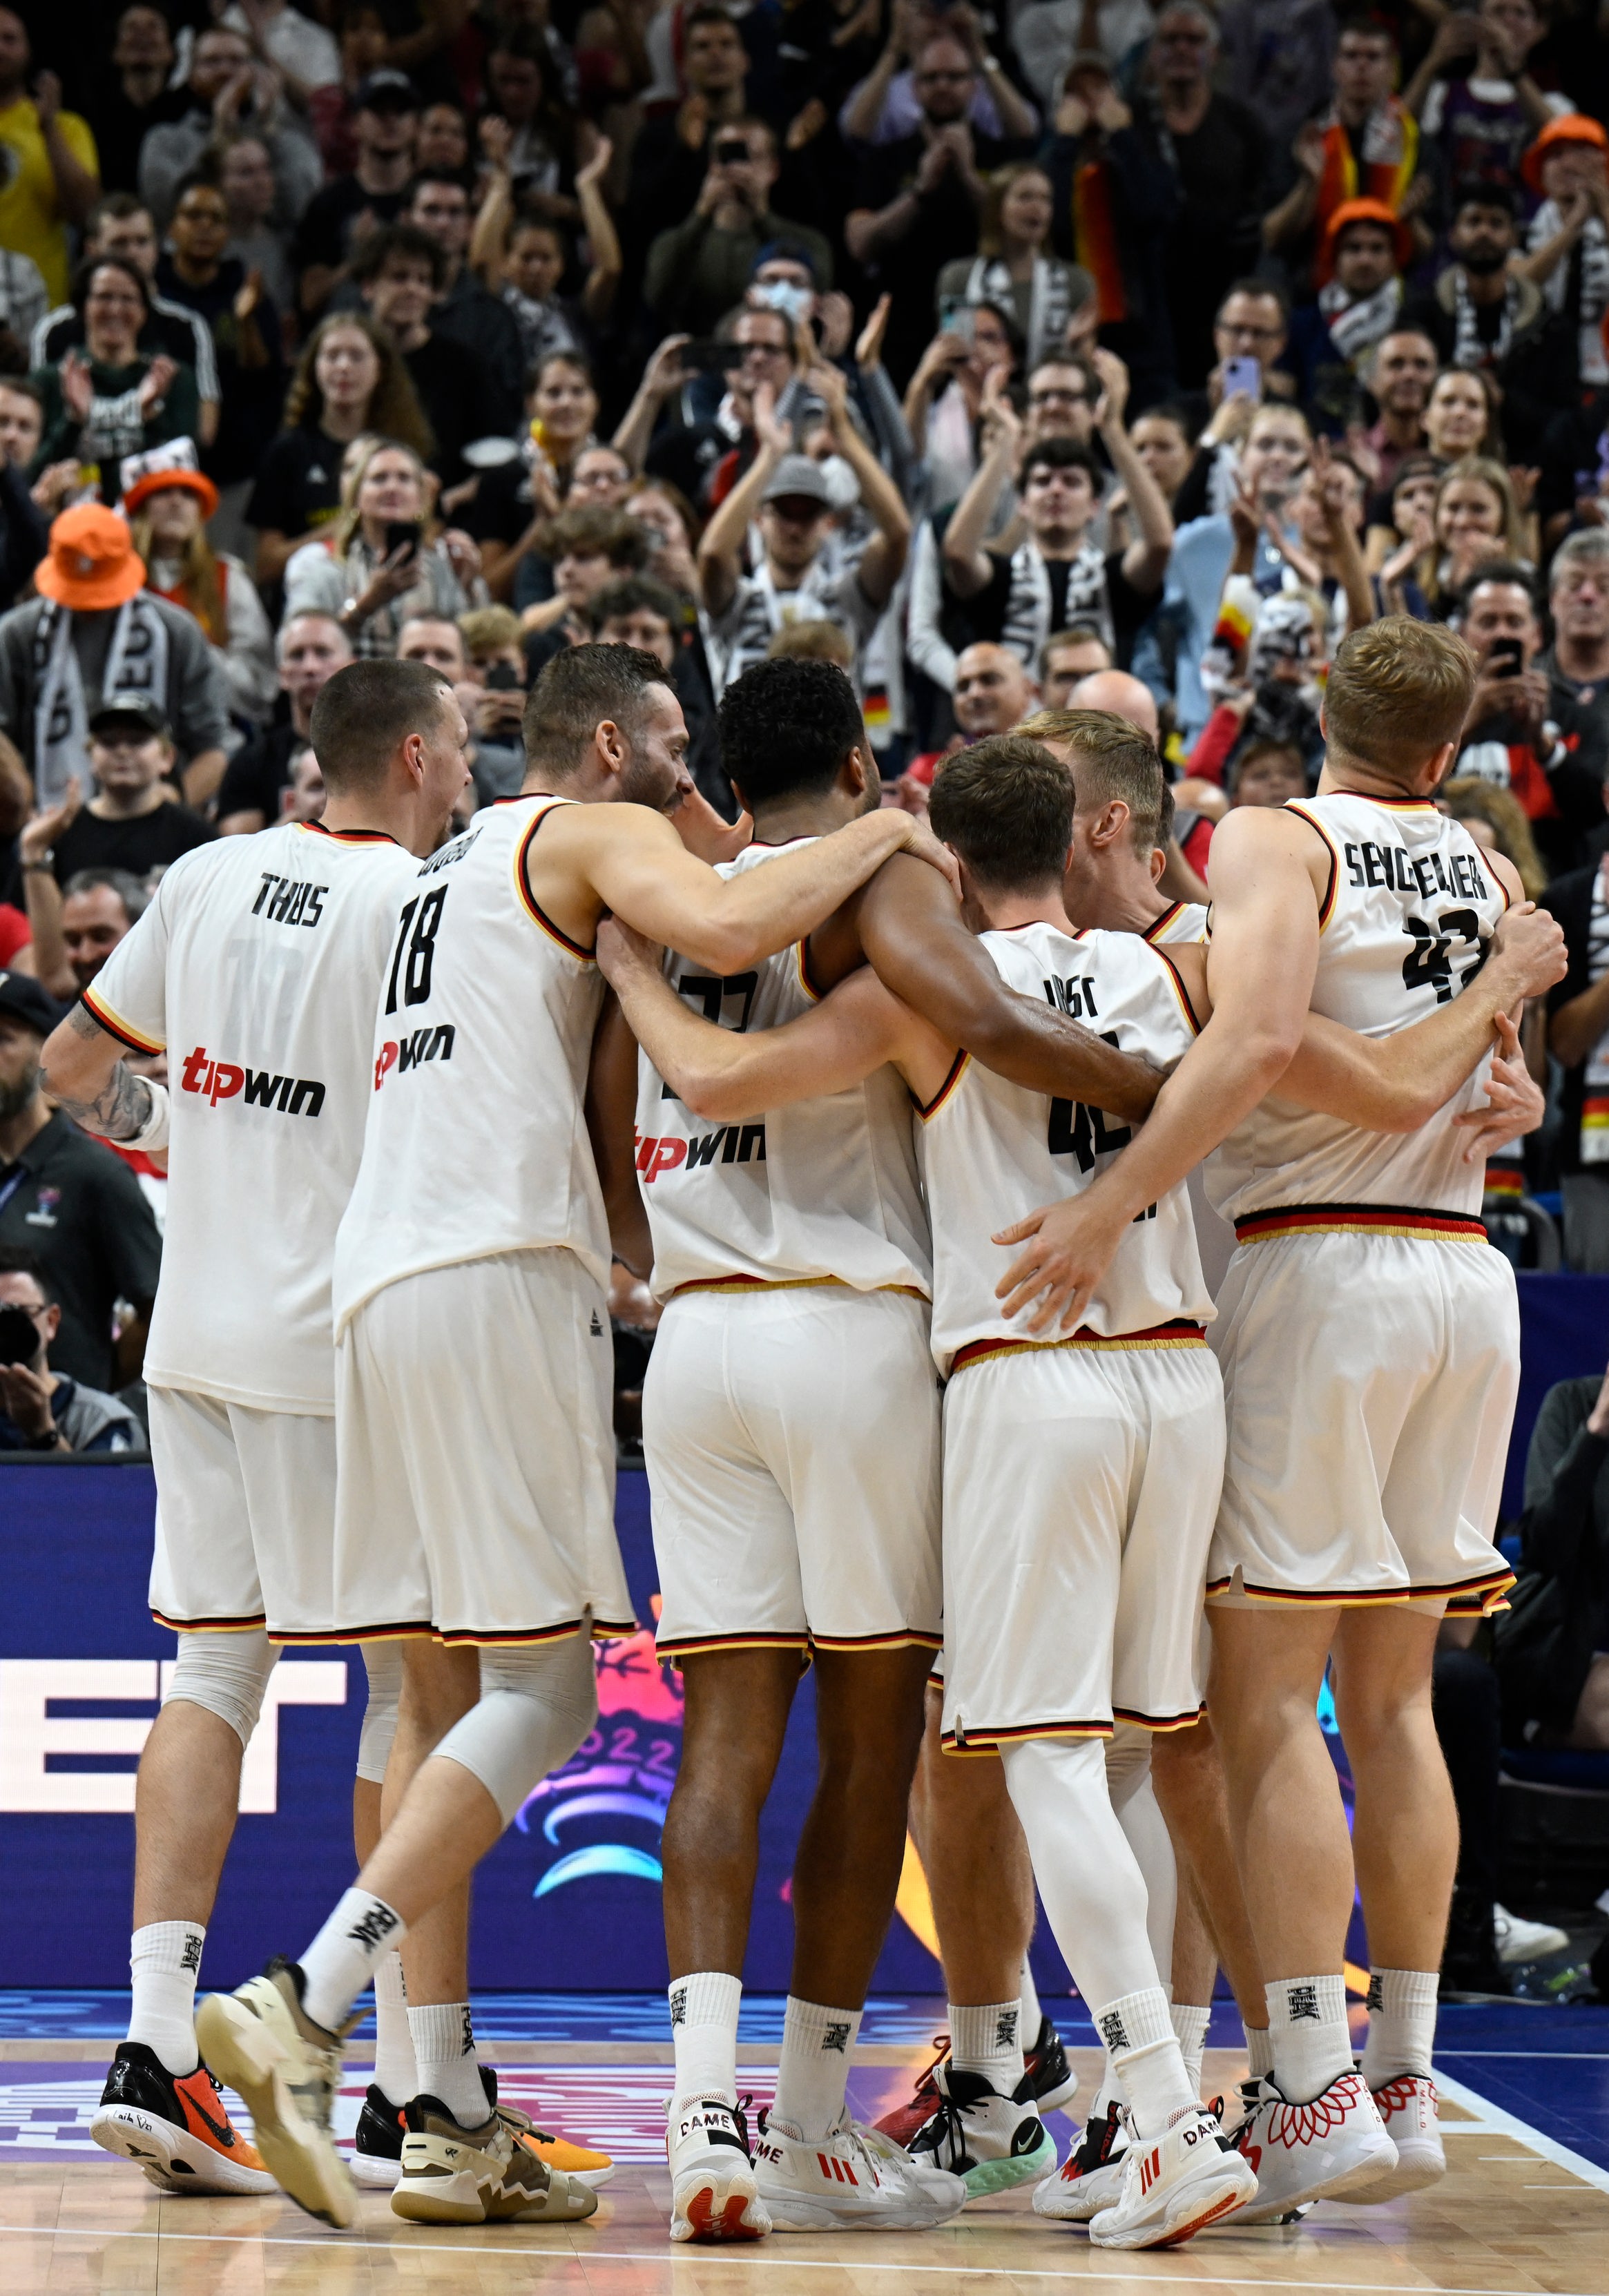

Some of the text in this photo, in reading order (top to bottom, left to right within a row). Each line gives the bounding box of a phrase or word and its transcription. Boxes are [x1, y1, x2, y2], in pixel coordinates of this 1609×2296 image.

[1345, 842, 1487, 900] SENGELER
[251, 872, 329, 927] THEIS
[385, 882, 449, 1015] 18
[182, 1047, 326, 1117] tipwin
[346, 1900, 399, 1954] PEAK
[180, 1933, 203, 1976] PEAK
[1287, 1985, 1321, 2022] PEAK
[996, 2009, 1019, 2048] PEAK
[1099, 2010, 1131, 2055] PEAK
[753, 2139, 784, 2165] ME
[1182, 2120, 1221, 2147] DAM
